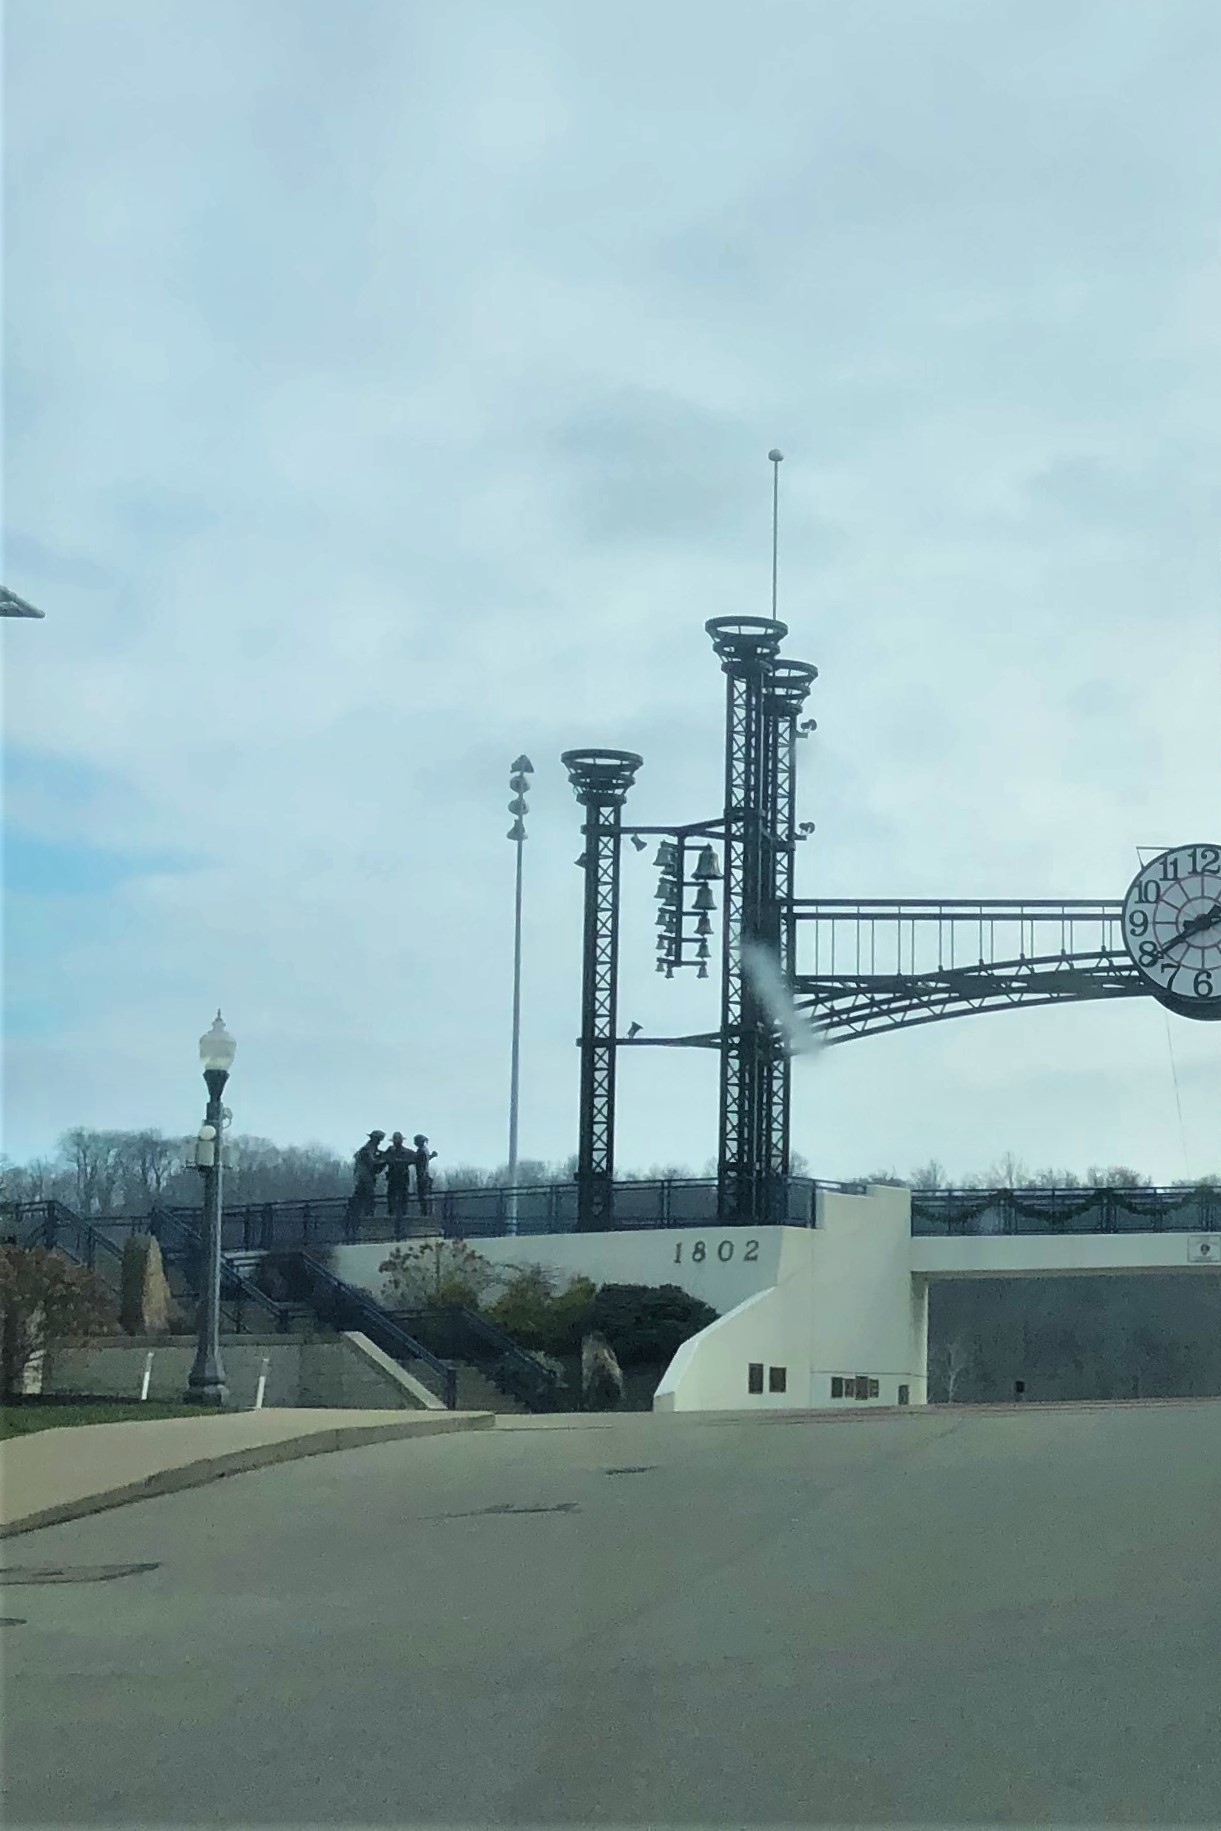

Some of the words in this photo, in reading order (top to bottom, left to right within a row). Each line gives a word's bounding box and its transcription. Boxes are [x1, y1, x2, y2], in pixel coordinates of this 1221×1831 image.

[1159, 856, 1179, 881] 11
[1188, 849, 1221, 875] 12
[1134, 879, 1161, 904] 10
[1129, 910, 1149, 937] 9
[1138, 940, 1160, 967] 8
[1161, 963, 1180, 991] 7
[1193, 970, 1213, 997] 6
[674, 1240, 759, 1263] 1802
